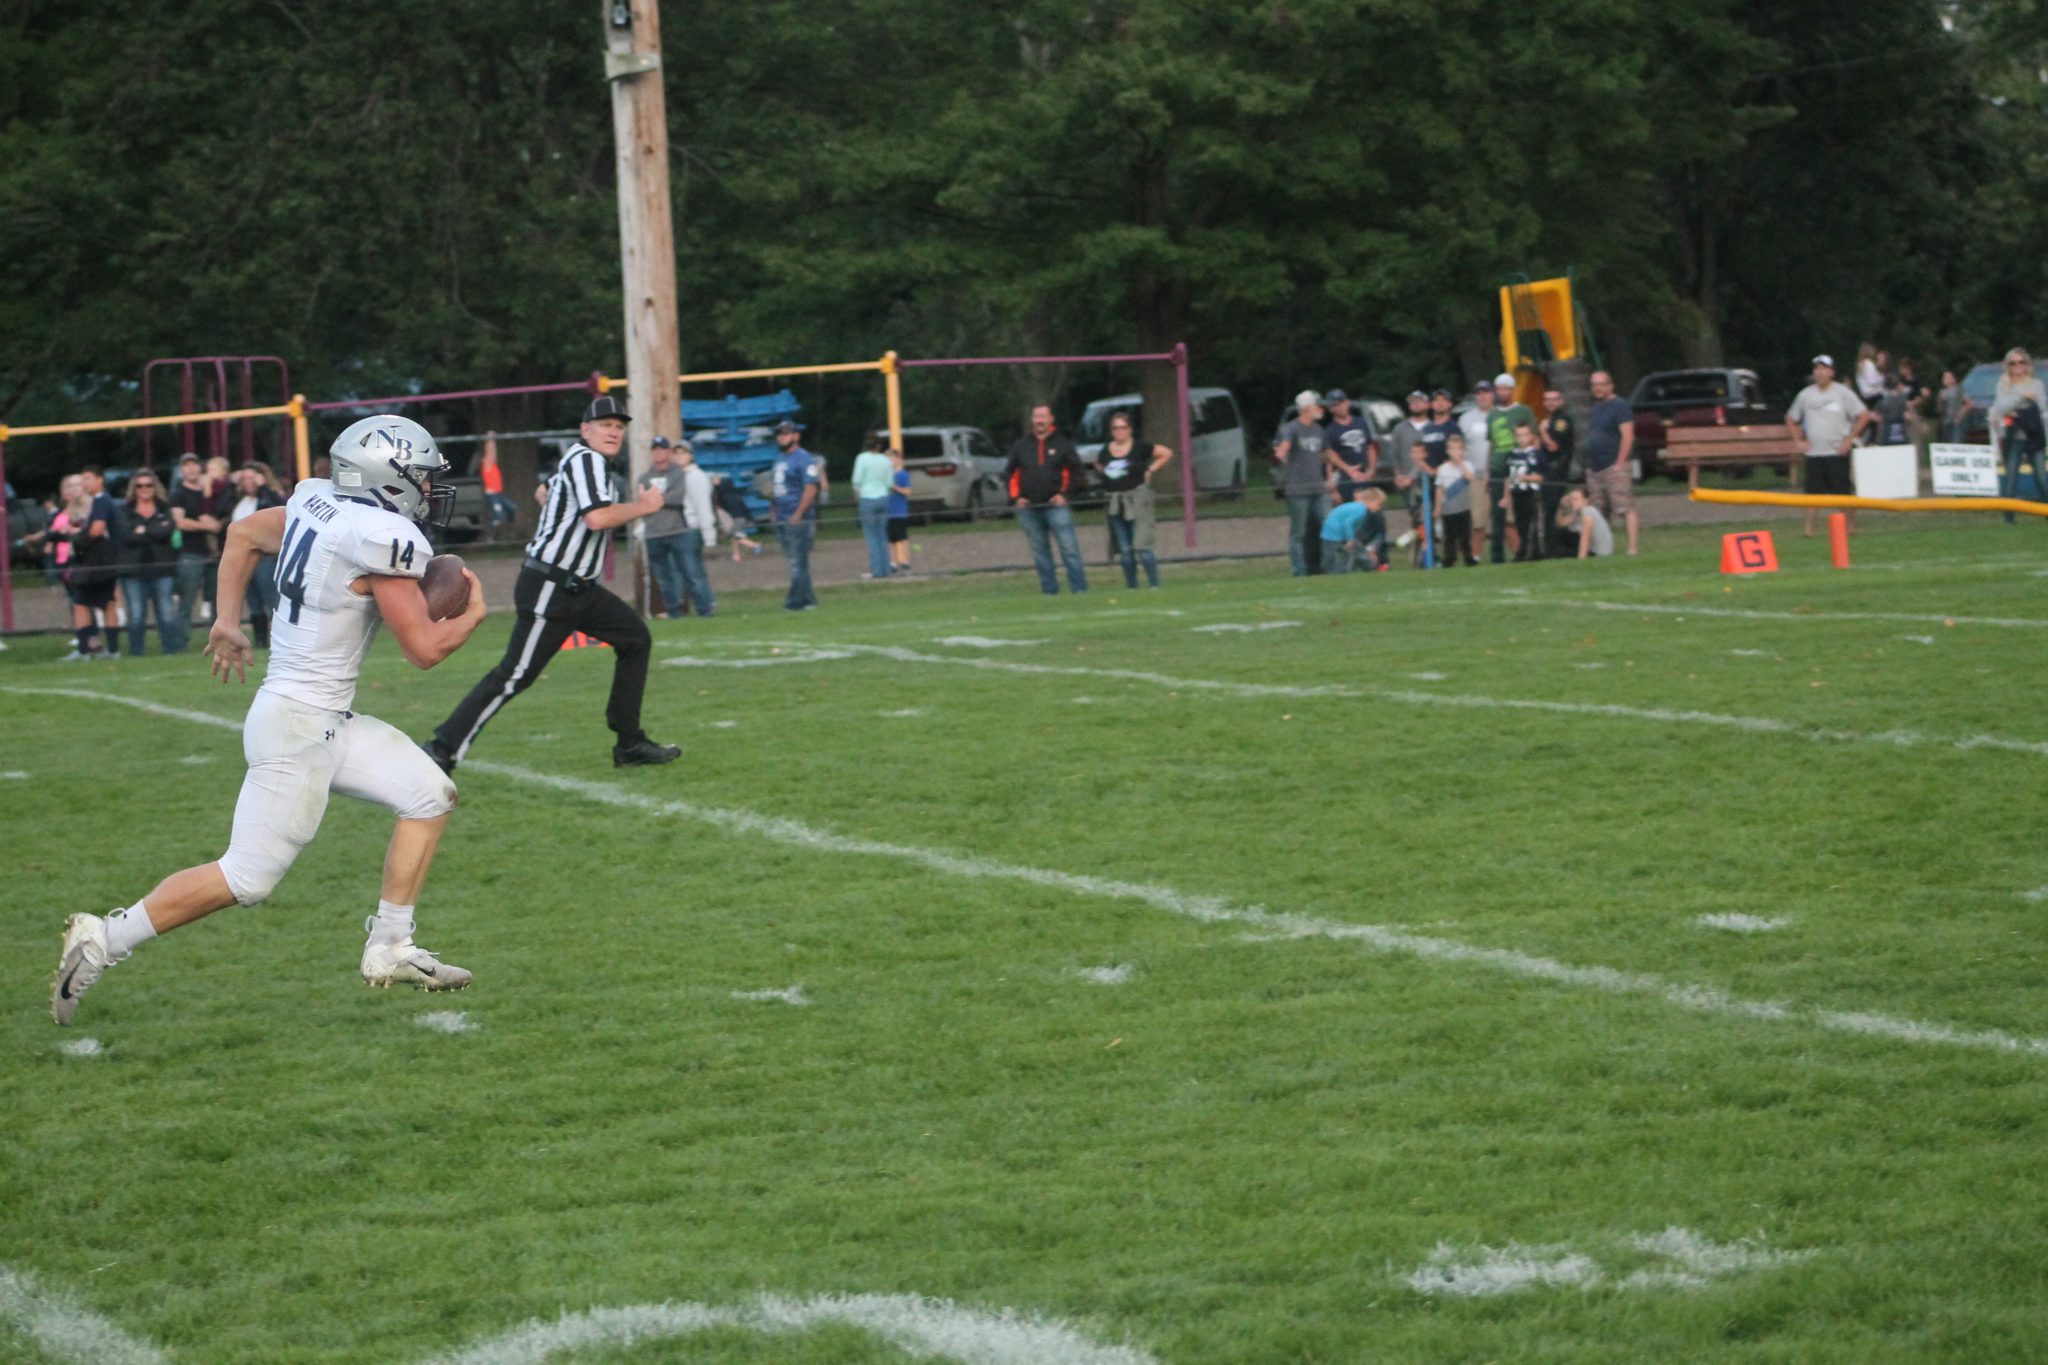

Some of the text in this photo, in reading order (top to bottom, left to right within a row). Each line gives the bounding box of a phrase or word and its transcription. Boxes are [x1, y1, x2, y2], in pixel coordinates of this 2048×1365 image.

[376, 429, 412, 460] NB
[1936, 456, 1991, 468] GAME USE
[1951, 472, 1980, 482] ONLY
[302, 494, 340, 524] MARTIN
[389, 538, 414, 570] 14
[1737, 534, 1766, 567] G
[276, 517, 318, 626] 14
